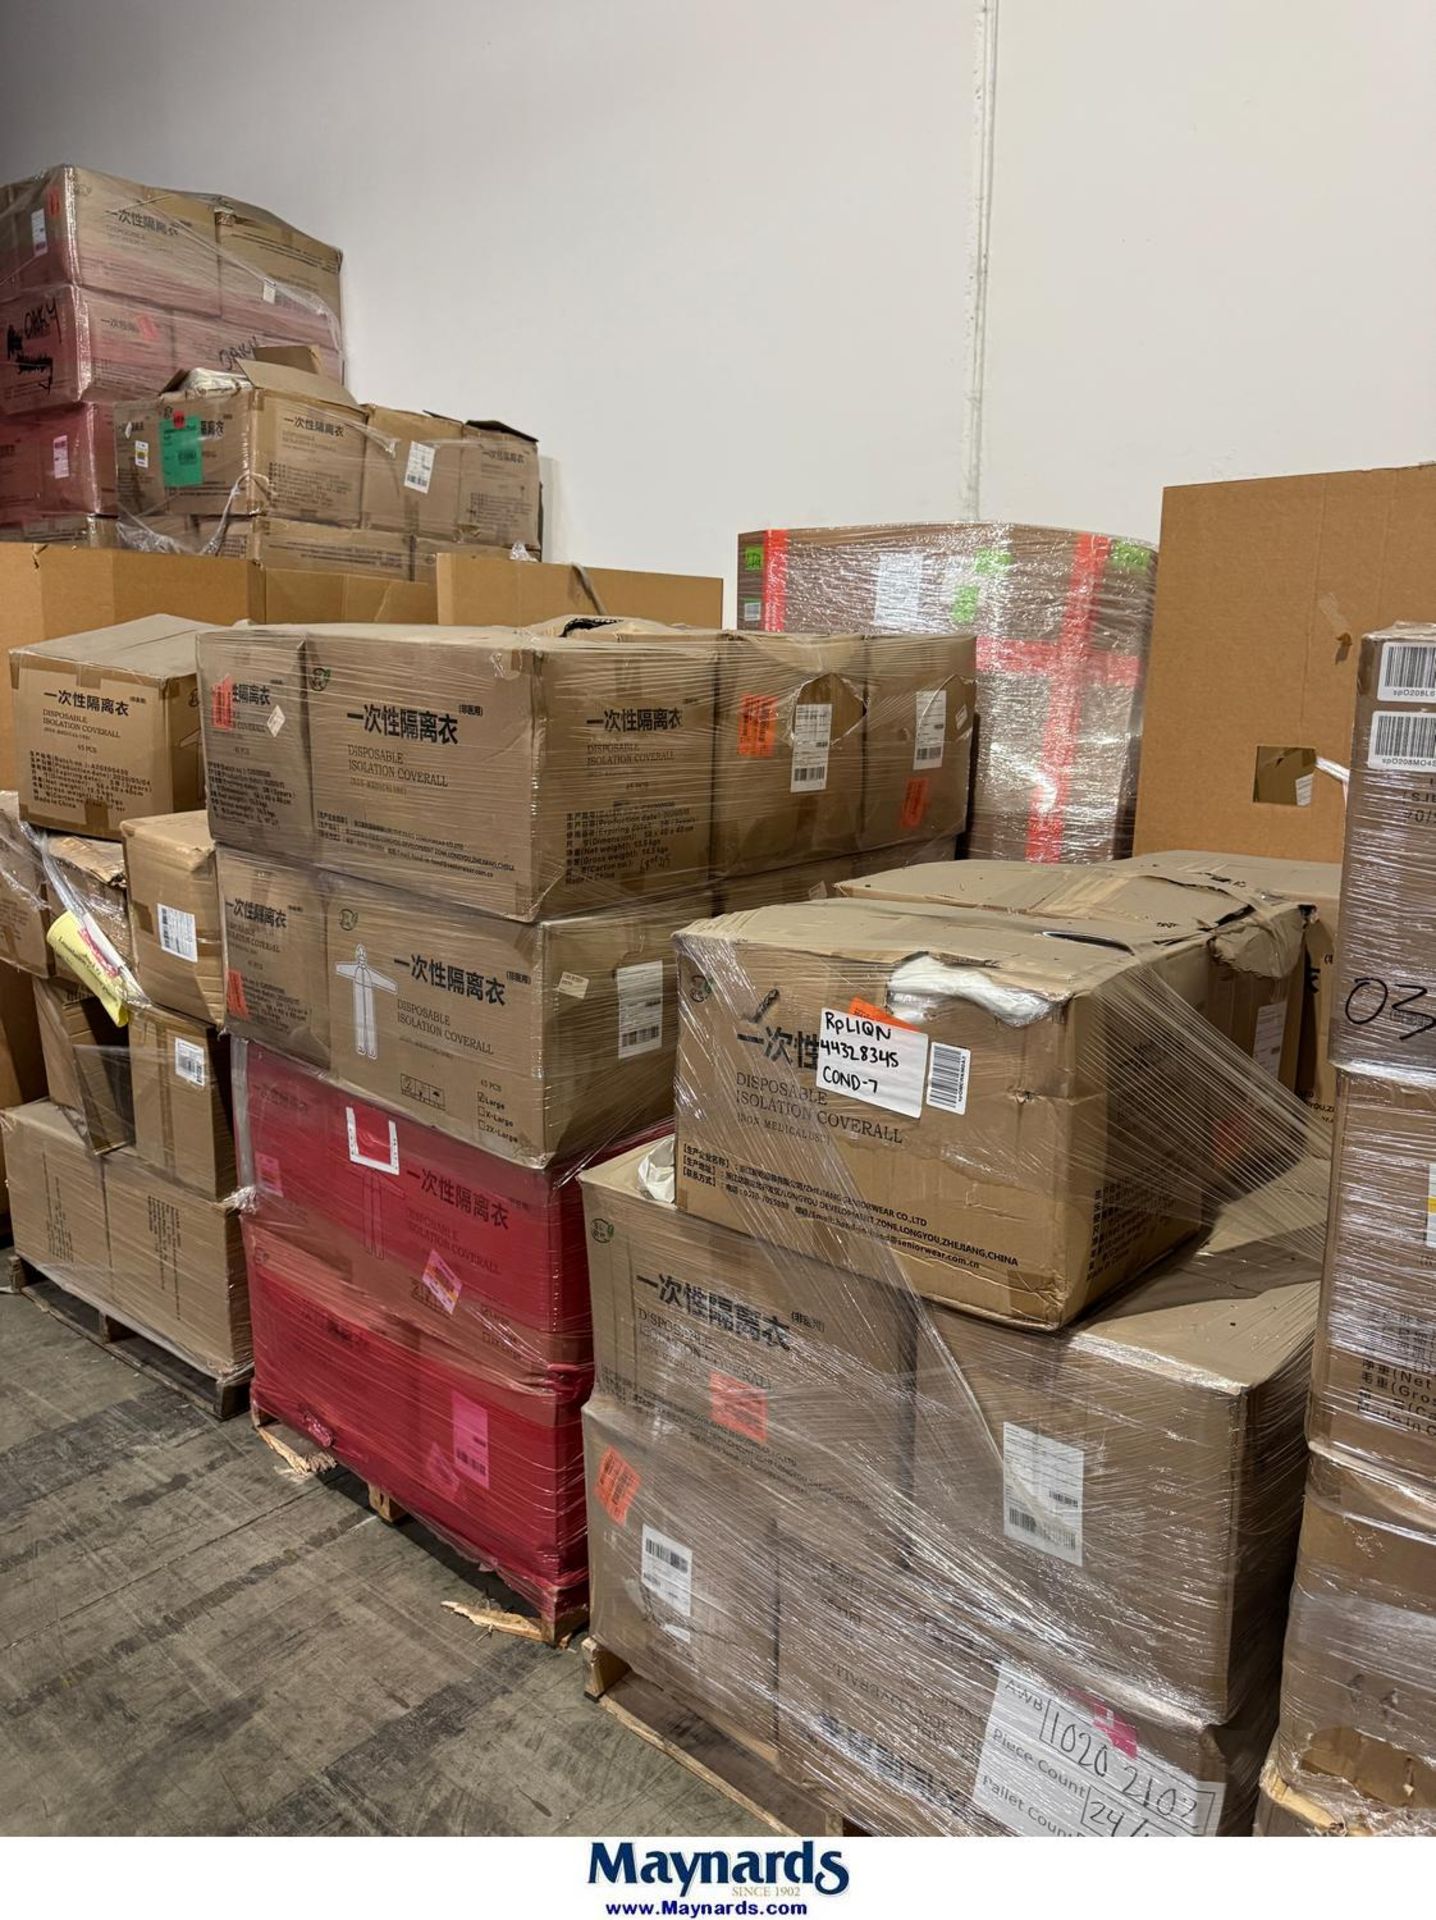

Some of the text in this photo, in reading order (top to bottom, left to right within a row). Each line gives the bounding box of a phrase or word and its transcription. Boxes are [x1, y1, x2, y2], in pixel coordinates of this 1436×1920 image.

[43, 709, 88, 724] DISPOSABLE
[44, 689, 129, 717] 一次性隔离衣
[586, 707, 684, 732] 一次性隔离衣
[43, 717, 81, 731] ISOLATION
[347, 704, 459, 744] 一次性隔离衣
[348, 744, 404, 765] DISPOSABLE
[349, 760, 449, 788] ISOLATION COVERALL
[226, 898, 287, 929] 一次性隔离衣
[394, 954, 506, 1006] 一次性隔离衣
[397, 999, 450, 1027] DISPOSABLE
[397, 1013, 494, 1055] ISOLATION COVERALL
[736, 1072, 829, 1107] DISPOSABLE
[822, 1065, 879, 1094] COND-7
[736, 1089, 903, 1144] ISOLATION COVERALL
[406, 1168, 509, 1230] 一次性隔离衣
[636, 1273, 791, 1351] 一次性隔离衣
[1004, 1679, 1044, 1712] AWB
[992, 1728, 1087, 1799] Piece Count
[982, 1775, 1025, 1811] Pallet
